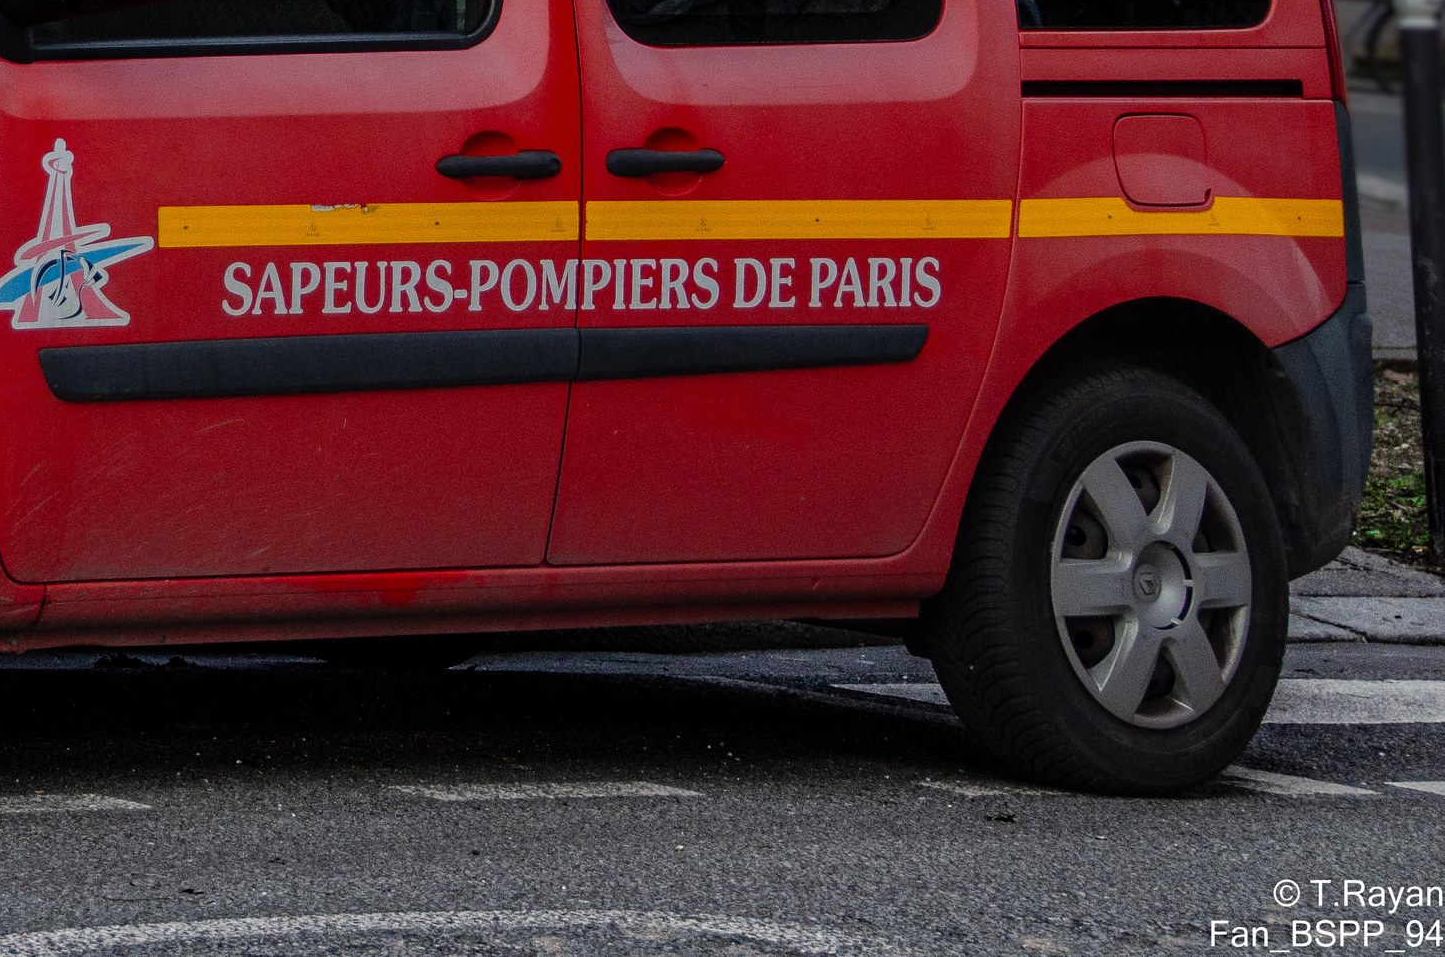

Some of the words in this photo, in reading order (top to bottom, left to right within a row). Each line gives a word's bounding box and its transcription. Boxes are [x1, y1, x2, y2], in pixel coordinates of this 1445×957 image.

[221, 257, 720, 316] SAPEURS-POMPIERS
[732, 258, 796, 309] DE
[809, 257, 942, 308] PARIS
